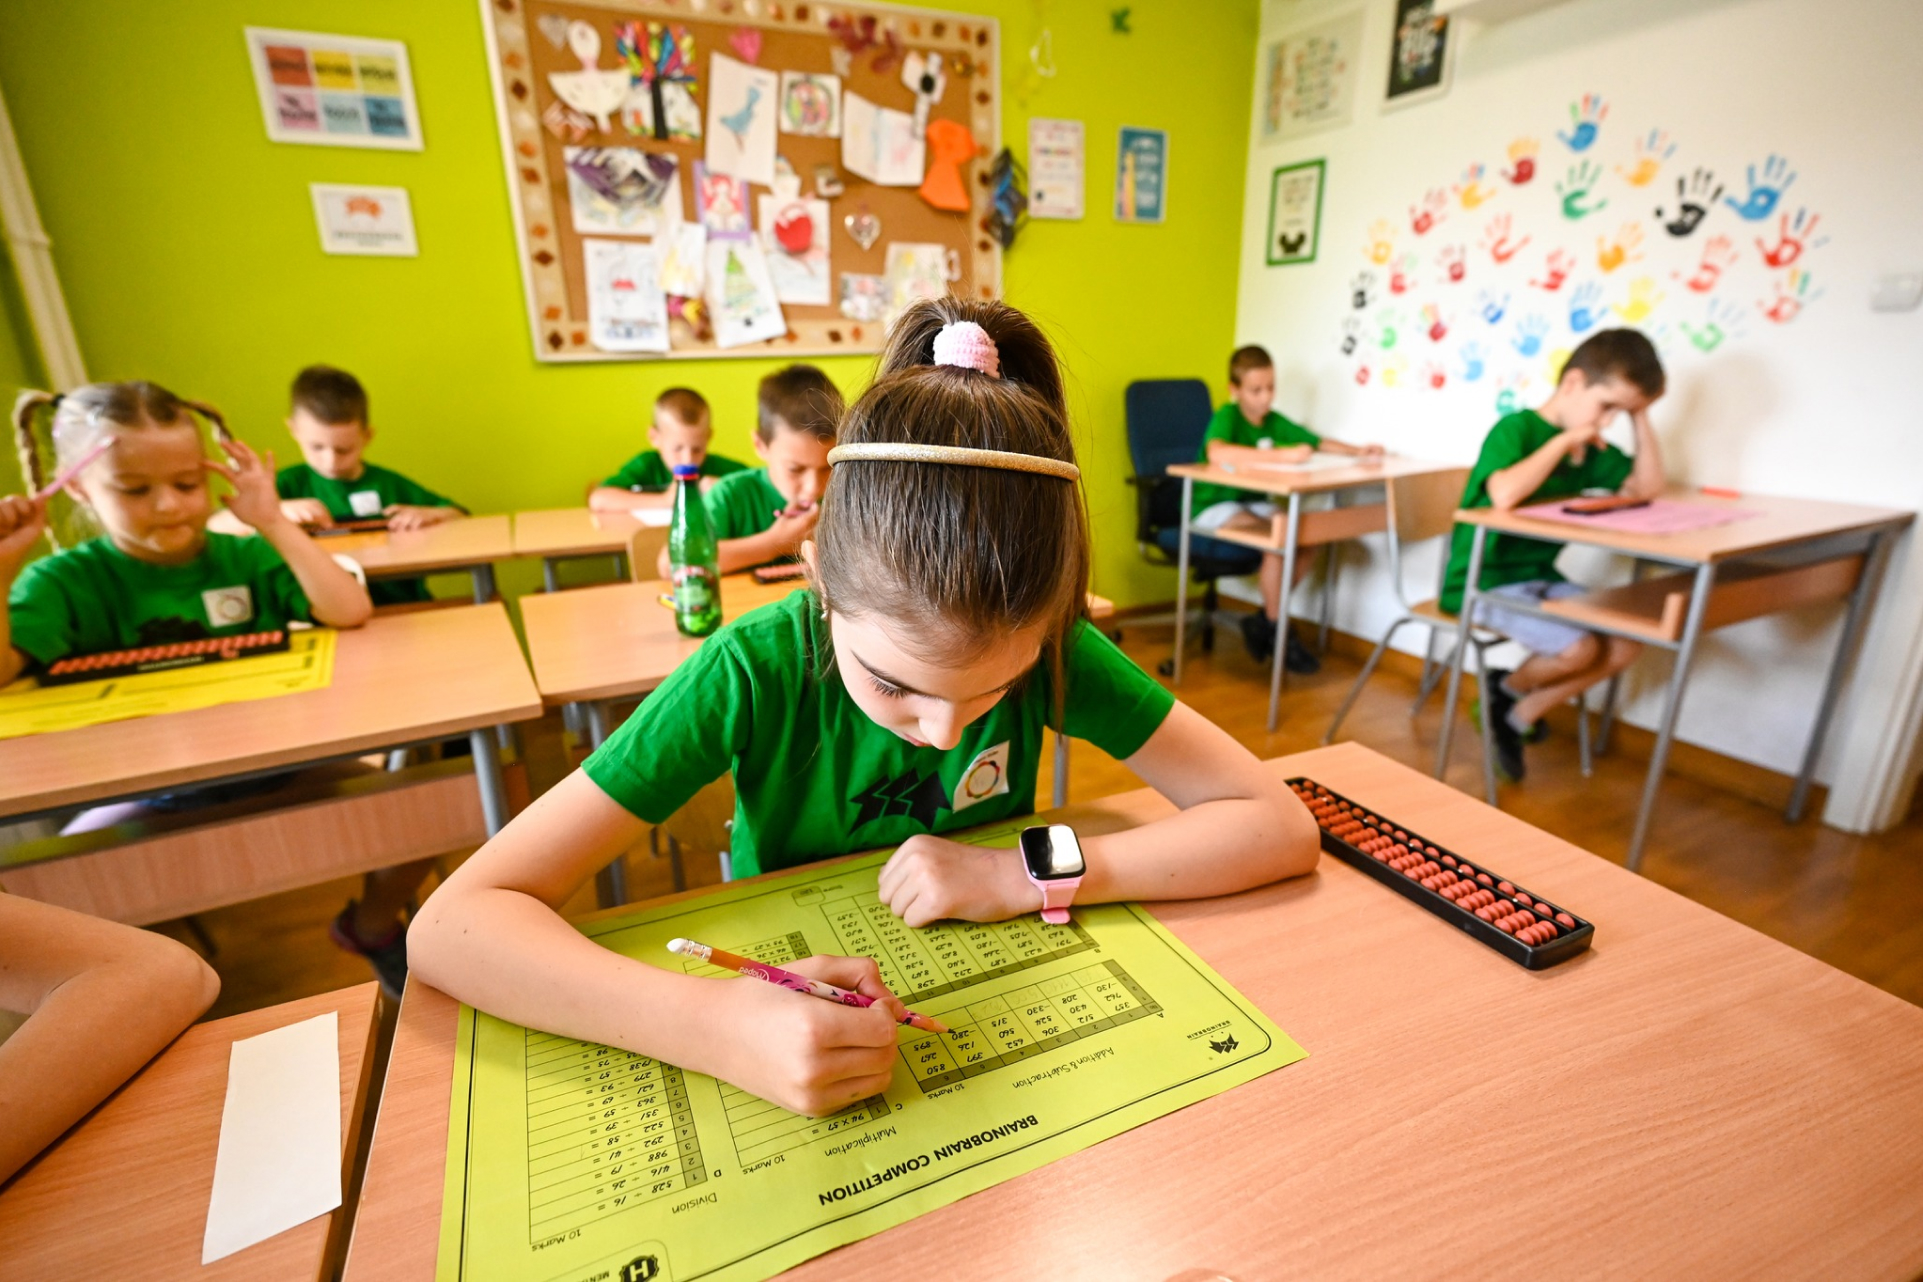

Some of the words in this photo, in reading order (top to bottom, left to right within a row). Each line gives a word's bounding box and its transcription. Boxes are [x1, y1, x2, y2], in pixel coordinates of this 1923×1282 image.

[1096, 982, 1116, 992] -130
[1062, 994, 1078, 1004] 208
[1104, 992, 1122, 1002] 762
[1026, 1004, 1050, 1015] -330
[1069, 1004, 1087, 1014] 430
[1115, 1001, 1130, 1011] 357
[991, 1018, 1007, 1027] 315
[1035, 1015, 1051, 1026] 524
[1077, 1013, 1093, 1023] 512
[999, 1028, 1015, 1038] 560
[1042, 1026, 1059, 1035] 306
[1187, 1020, 1230, 1039] BRAINOBRAIN
[913, 1041, 937, 1051] -895
[958, 1041, 975, 1051] 126
[1006, 1038, 1024, 1048] 652
[597, 1048, 608, 1056] 98
[920, 1052, 937, 1062] 267
[966, 1052, 983, 1062] 397
[1076, 1047, 1114, 1066] Addition
[927, 1064, 945, 1075] 850
[1070, 1060, 1078, 1070] &
[599, 1071, 611, 1079] 57
[634, 1071, 651, 1082] 279
[1012, 1063, 1071, 1090] Subtraction
[601, 1084, 614, 1092] 93
[637, 1084, 654, 1094] 621
[955, 1083, 964, 1091] 10
[927, 1086, 953, 1100] Marks
[602, 1097, 614, 1105] 69
[637, 1097, 656, 1107] 363
[604, 1109, 616, 1118] 59
[641, 1109, 658, 1120] 351
[606, 1122, 618, 1131] 39
[643, 1121, 664, 1133] 522
[827, 1121, 838, 1131] 57
[607, 1135, 620, 1145] 58
[644, 1135, 664, 1147] 292
[824, 1126, 896, 1156] Multiplication
[933, 1114, 1038, 1161] BRAINOBRAIN
[609, 1150, 621, 1160] 41
[648, 1150, 668, 1162] 988
[774, 1154, 785, 1163] 10
[611, 1165, 622, 1174] 19
[651, 1165, 670, 1176] 416
[743, 1160, 771, 1175] Marks
[612, 1180, 626, 1190] 26
[818, 1155, 930, 1206] COMPETITION
[651, 1180, 672, 1193] 528
[614, 1196, 627, 1206] 16
[671, 1192, 717, 1215] Division
[569, 1229, 581, 1239] 10
[532, 1235, 565, 1252] Marks
